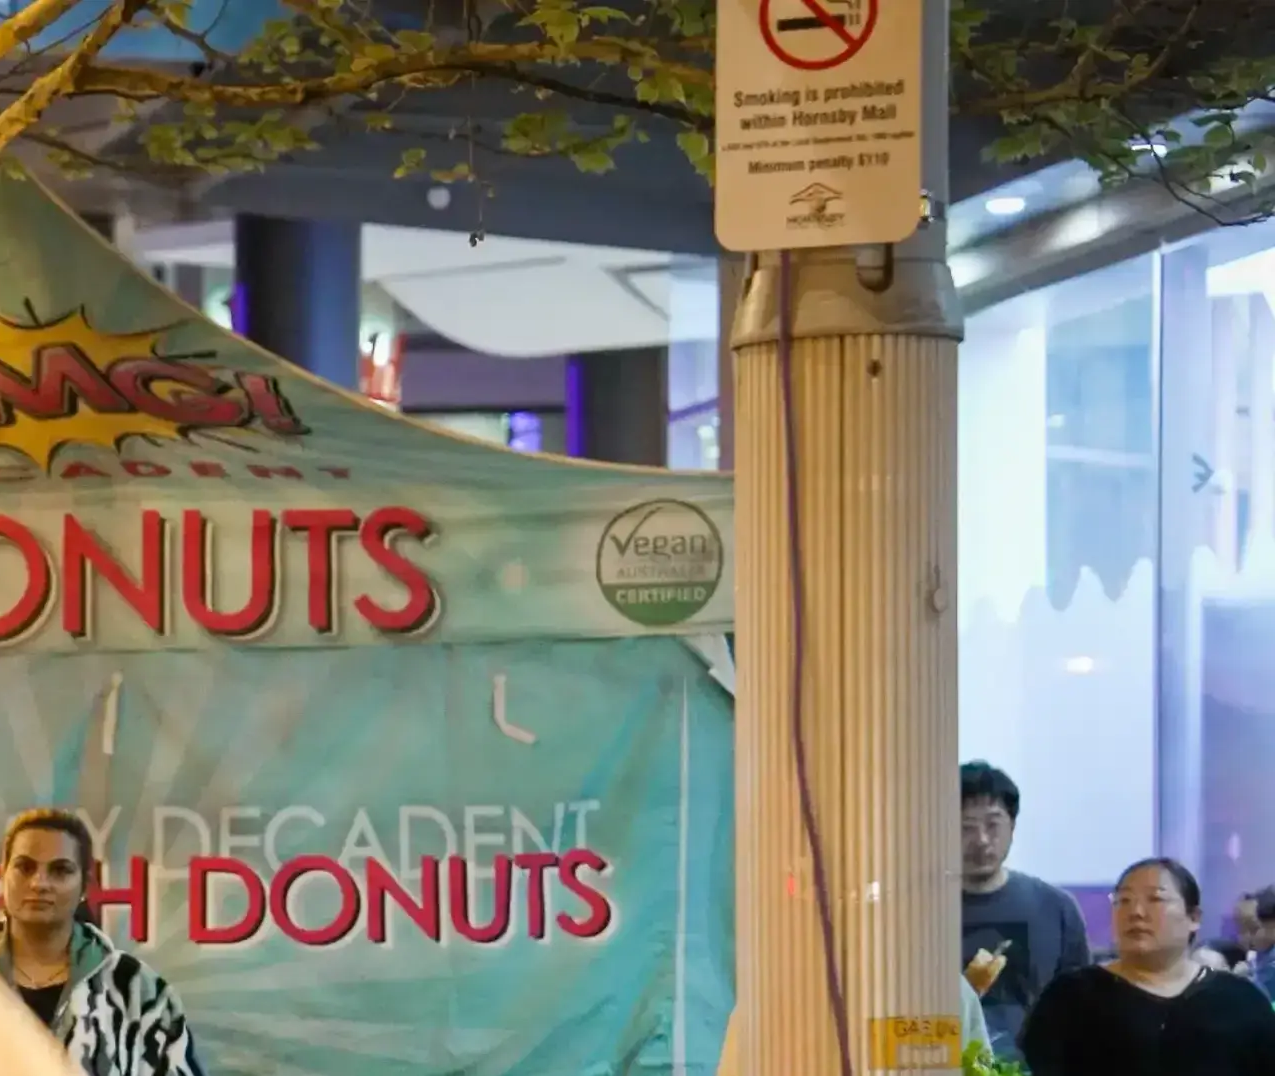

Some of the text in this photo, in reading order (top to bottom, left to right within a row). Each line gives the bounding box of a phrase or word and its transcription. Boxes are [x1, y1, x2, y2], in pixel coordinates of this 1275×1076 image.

[734, 79, 905, 107] Smoking is prohibited
[740, 104, 897, 130] within Hornsby Mall
[748, 152, 890, 174] Minimum penalty $110
[610, 506, 707, 560] Vegan
[615, 586, 707, 605] CERTIFIED
[154, 800, 600, 879] DECADENT
[189, 848, 613, 946] DONUTS
